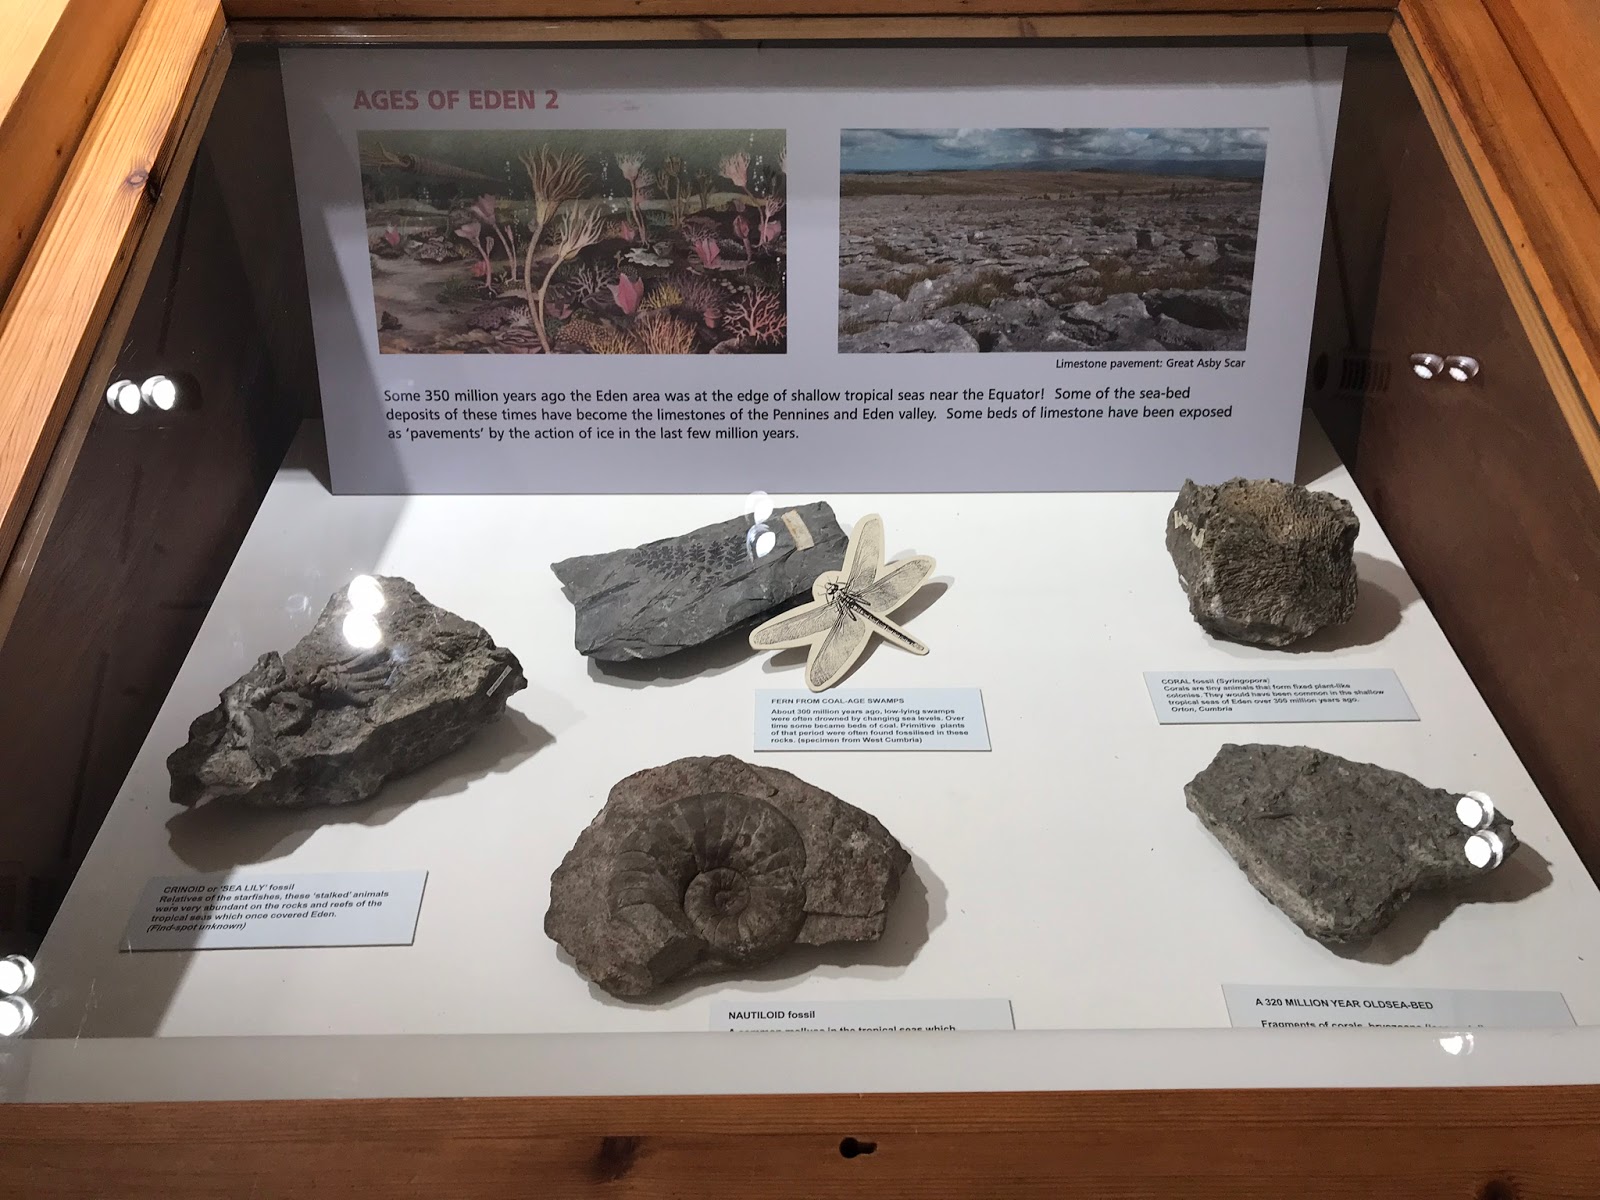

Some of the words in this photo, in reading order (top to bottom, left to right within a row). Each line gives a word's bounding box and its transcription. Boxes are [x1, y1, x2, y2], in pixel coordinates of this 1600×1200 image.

[354, 90, 419, 110] AGES
[428, 90, 460, 110] OF
[469, 90, 536, 110] EDEN
[545, 90, 559, 110] 2
[1055, 358, 1107, 368] Limestone
[1109, 358, 1162, 370] pavement:
[1166, 358, 1194, 368] Great
[1196, 357, 1221, 370] Asby
[1224, 358, 1245, 367] Scar
[384, 390, 420, 401] Some
[424, 389, 449, 401] 350
[454, 389, 498, 401] million
[502, 392, 536, 404] years
[541, 392, 565, 404] ago
[570, 389, 591, 401] the
[596, 389, 628, 401] Eden
[632, 392, 659, 401] area
[664, 392, 690, 401] was
[694, 390, 707, 401] at
[711, 389, 732, 401] the
[737, 389, 768, 404] edge
[773, 388, 787, 401] of
[791, 388, 840, 401] shallow
[844, 388, 892, 403] tropical
[898, 391, 924, 400] seas
[929, 391, 958, 400] near
[962, 388, 984, 400] the
[988, 388, 1044, 403] Equator!
[1054, 387, 1091, 399] Some
[1095, 386, 1110, 399] of
[1113, 386, 1135, 399] the
[1139, 386, 1190, 398] sea-bed
[385, 408, 440, 422] deposits
[444, 408, 458, 420] of
[462, 408, 497, 420] these
[501, 408, 536, 420] times
[541, 408, 571, 420] have
[576, 408, 627, 420] become
[631, 408, 652, 420] the
[657, 408, 725, 420] limestones
[729, 407, 743, 420] of
[747, 407, 768, 420] the
[773, 408, 829, 420] Pennines
[833, 407, 857, 420] and
[862, 407, 893, 419] Eden
[898, 407, 936, 422] valley.
[946, 407, 982, 419] Some
[987, 406, 1017, 418] beds
[1022, 406, 1036, 418] of
[1040, 406, 1103, 418] limestone
[1108, 406, 1138, 418] have
[1142, 405, 1174, 417] been
[1179, 405, 1232, 420] exposed
[387, 430, 401, 439] as
[488, 426, 504, 441] by
[508, 426, 530, 438] the
[534, 426, 574, 438] action
[578, 426, 592, 438] of
[596, 426, 614, 438] ice
[618, 427, 630, 438] in
[634, 426, 656, 439] the
[660, 426, 682, 438] last
[686, 426, 711, 438] few
[715, 426, 758, 438] million
[762, 429, 798, 441] years.
[159, 896, 202, 904] Relatives
[203, 903, 248, 912] abundant
[151, 914, 188, 922] tropical
[189, 913, 212, 922] seas
[214, 912, 242, 920] which
[146, 924, 198, 932] (Find-spot
[198, 922, 246, 931] unknown)
[1264, 998, 1282, 1006] 320
[1284, 998, 1329, 1007] MILLION
[1330, 999, 1361, 1007] YEAR
[728, 1010, 784, 1019] NAUTILOID
[788, 1010, 815, 1018] fossil
